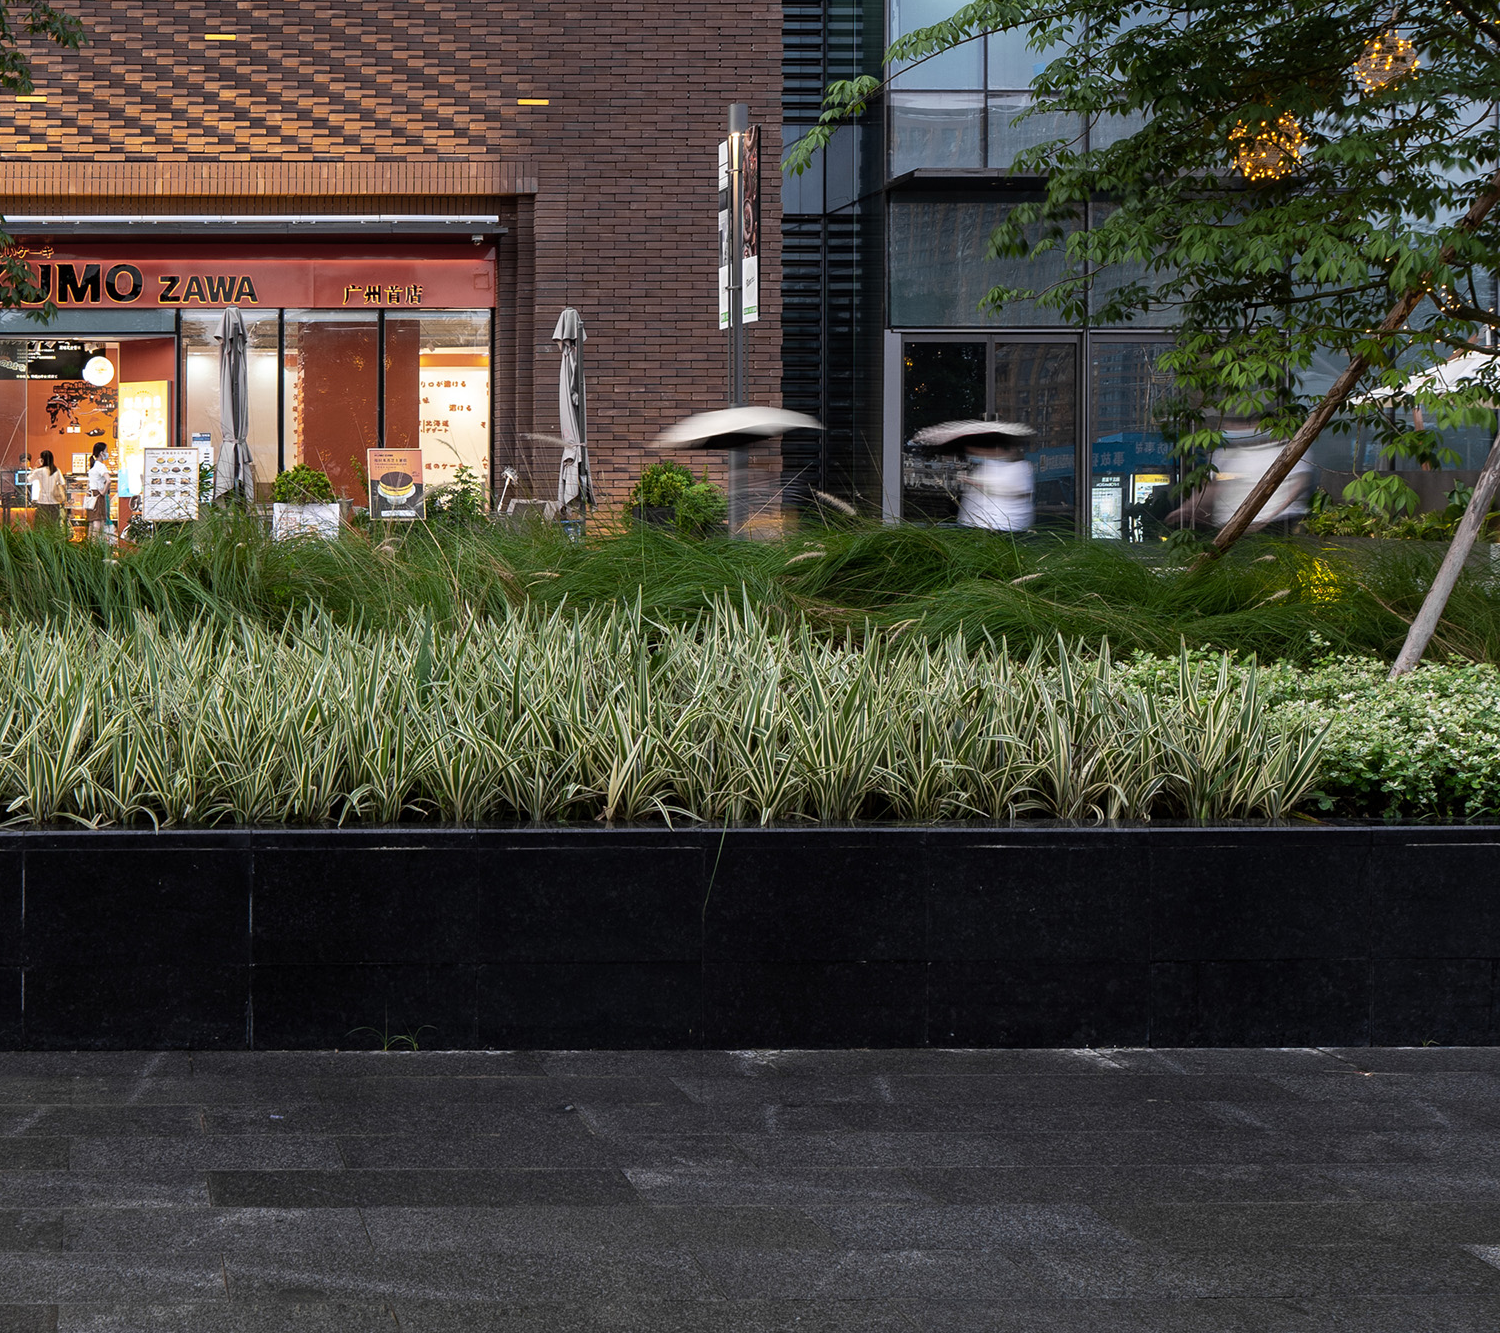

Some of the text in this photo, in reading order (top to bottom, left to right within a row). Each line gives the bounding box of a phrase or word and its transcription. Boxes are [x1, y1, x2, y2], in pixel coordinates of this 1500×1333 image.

[158, 275, 259, 304] ZAWA
[342, 284, 424, 305] 广州首店
